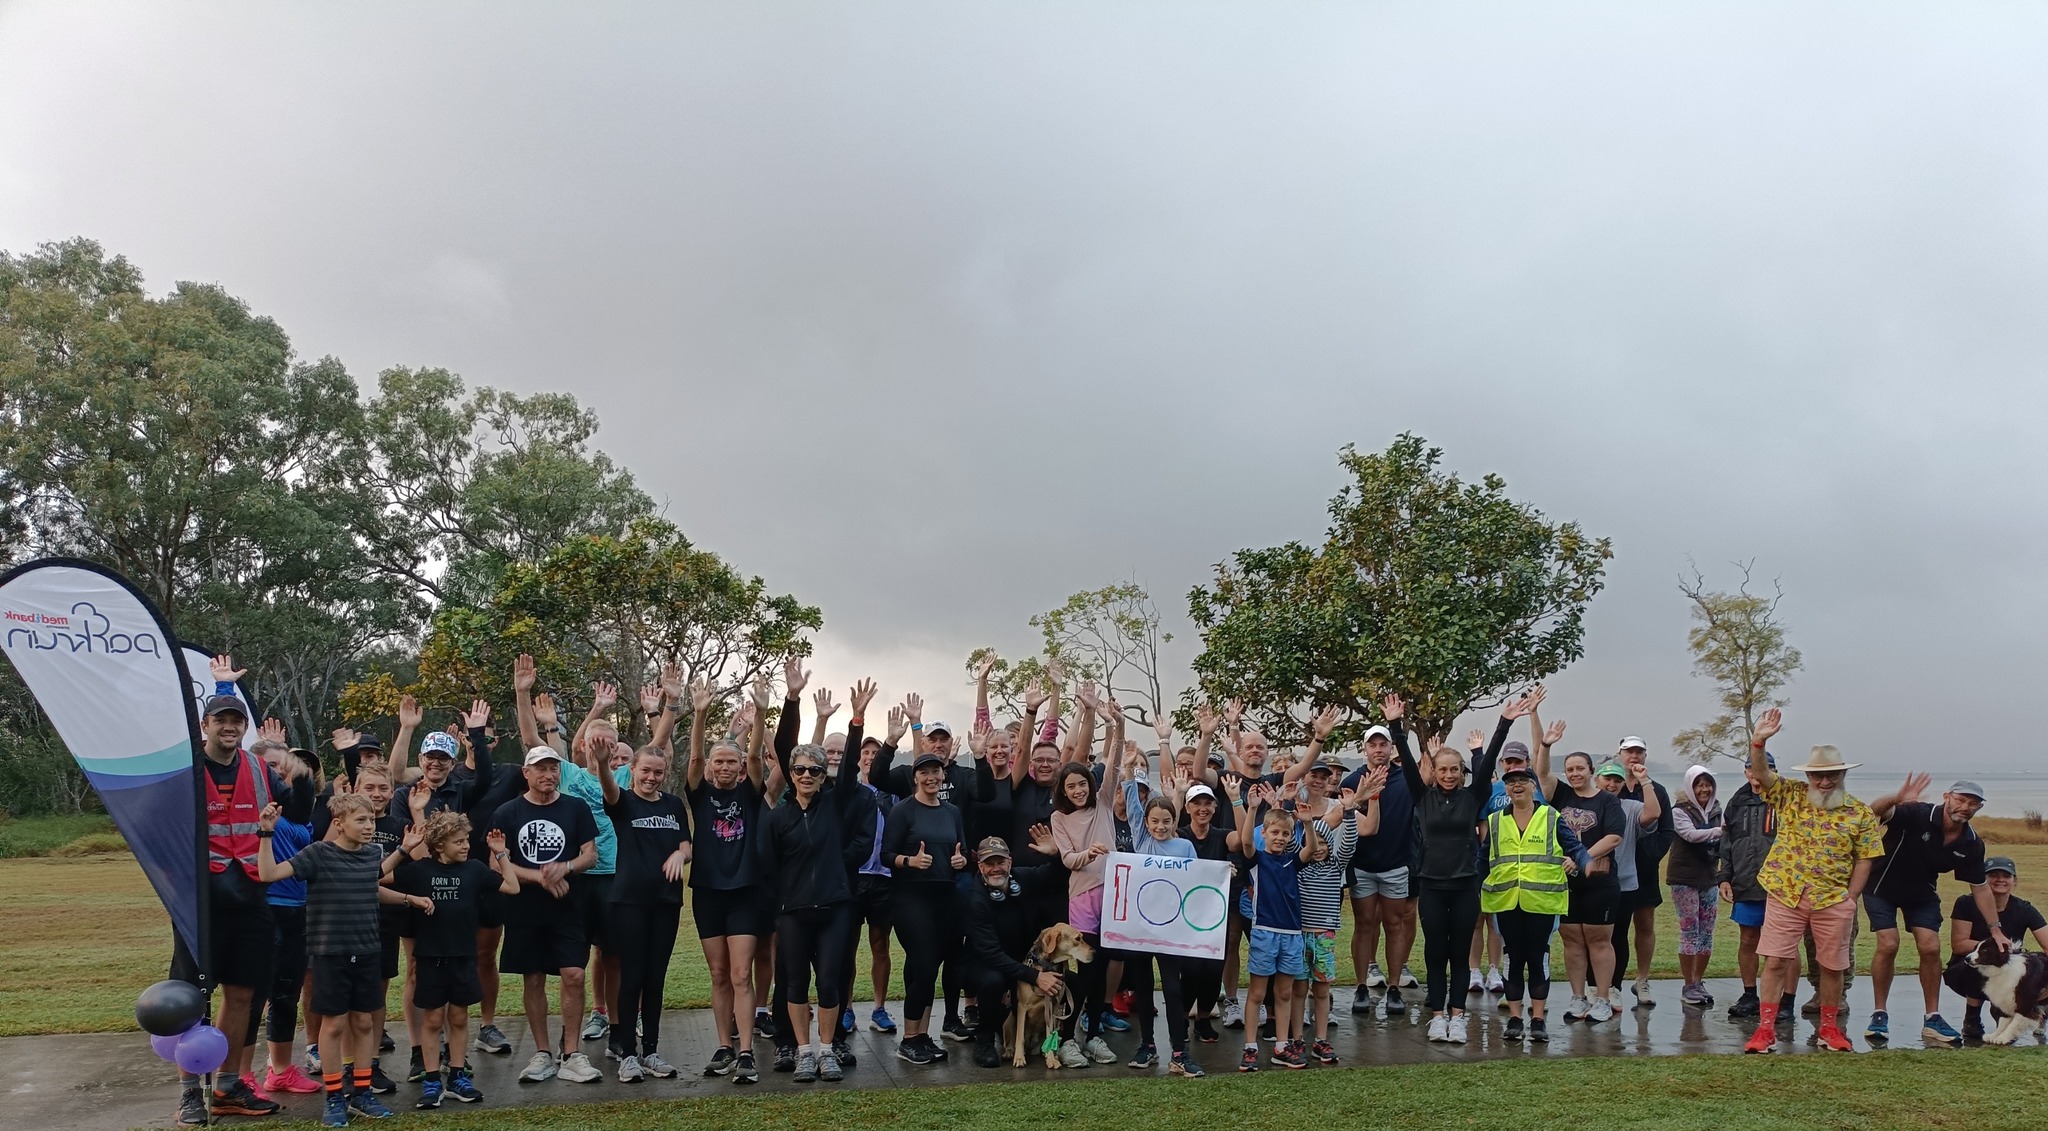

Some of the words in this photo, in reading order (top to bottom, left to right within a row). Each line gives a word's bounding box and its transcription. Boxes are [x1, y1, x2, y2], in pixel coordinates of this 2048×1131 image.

[206, 801, 224, 811] arkrun
[538, 823, 546, 832] 2
[1143, 857, 1194, 872] EVENT
[431, 877, 448, 886] BORN
[451, 877, 460, 886] TO
[431, 890, 459, 900] SKATE
[1113, 864, 1227, 932] 100
